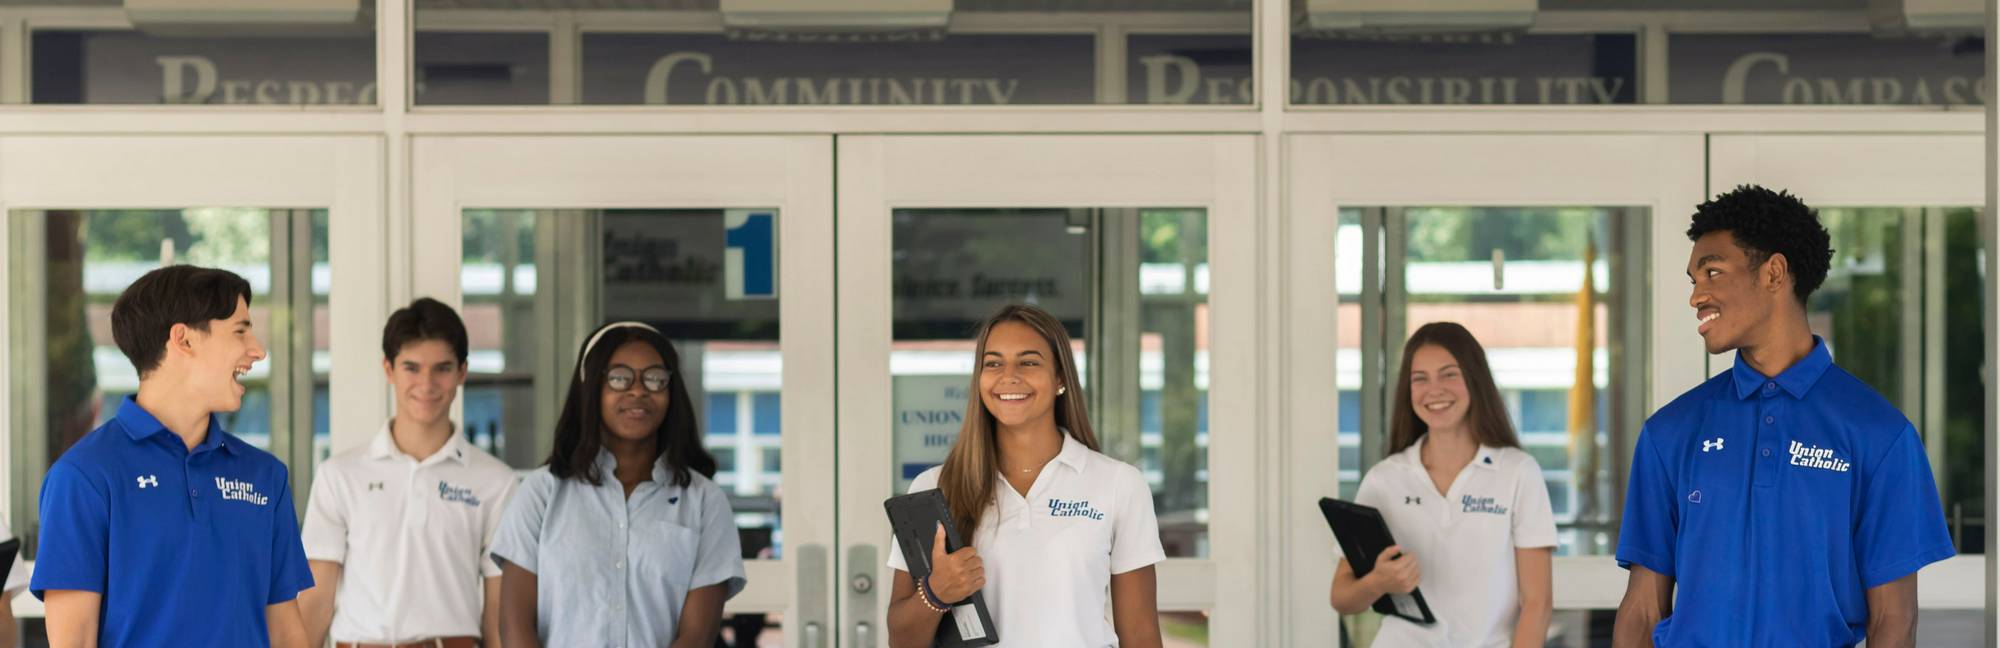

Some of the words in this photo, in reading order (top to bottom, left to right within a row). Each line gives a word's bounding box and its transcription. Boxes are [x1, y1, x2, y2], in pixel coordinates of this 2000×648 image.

[644, 51, 1019, 104] COMMUNITY
[725, 213, 773, 295] 1
[1789, 440, 1834, 459] Union
[1790, 454, 1850, 472] Catholic
[215, 476, 254, 493] Union
[222, 488, 269, 506] Catholic
[1048, 498, 1089, 511] Union
[1462, 494, 1495, 505] Union
[1050, 507, 1105, 521] Catholic
[1462, 503, 1508, 515] Catholic
